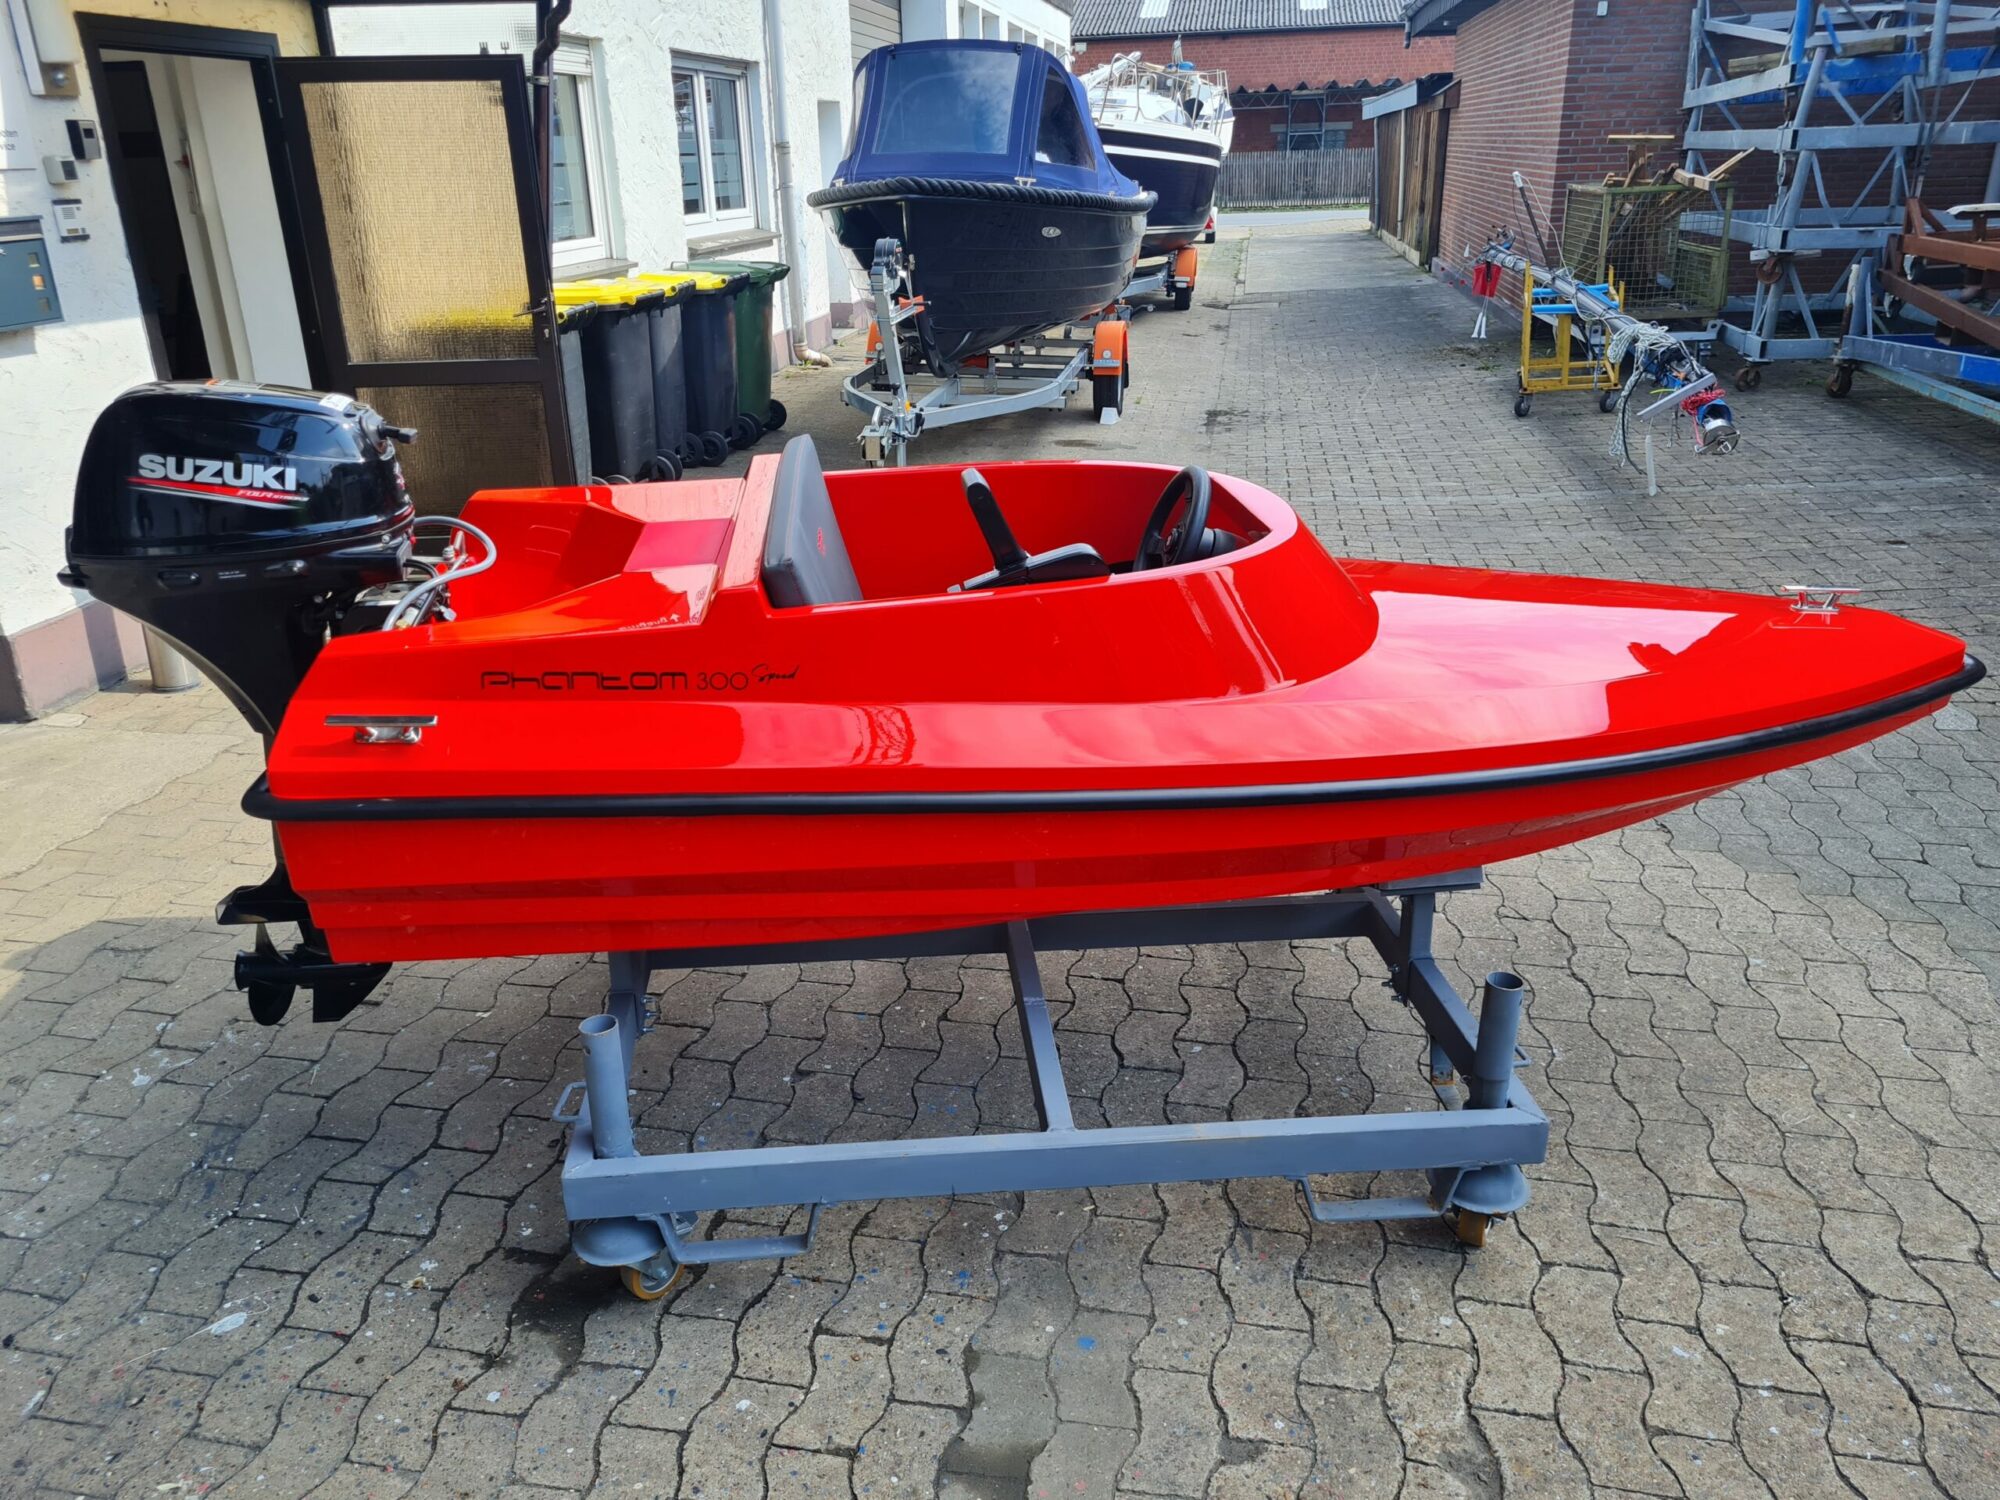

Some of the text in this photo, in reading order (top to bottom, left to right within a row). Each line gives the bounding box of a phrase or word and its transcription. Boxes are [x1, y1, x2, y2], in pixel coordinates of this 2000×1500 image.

[138, 454, 297, 491] SUZUKI
[236, 489, 273, 499] FOUR
[697, 671, 749, 691] 300
